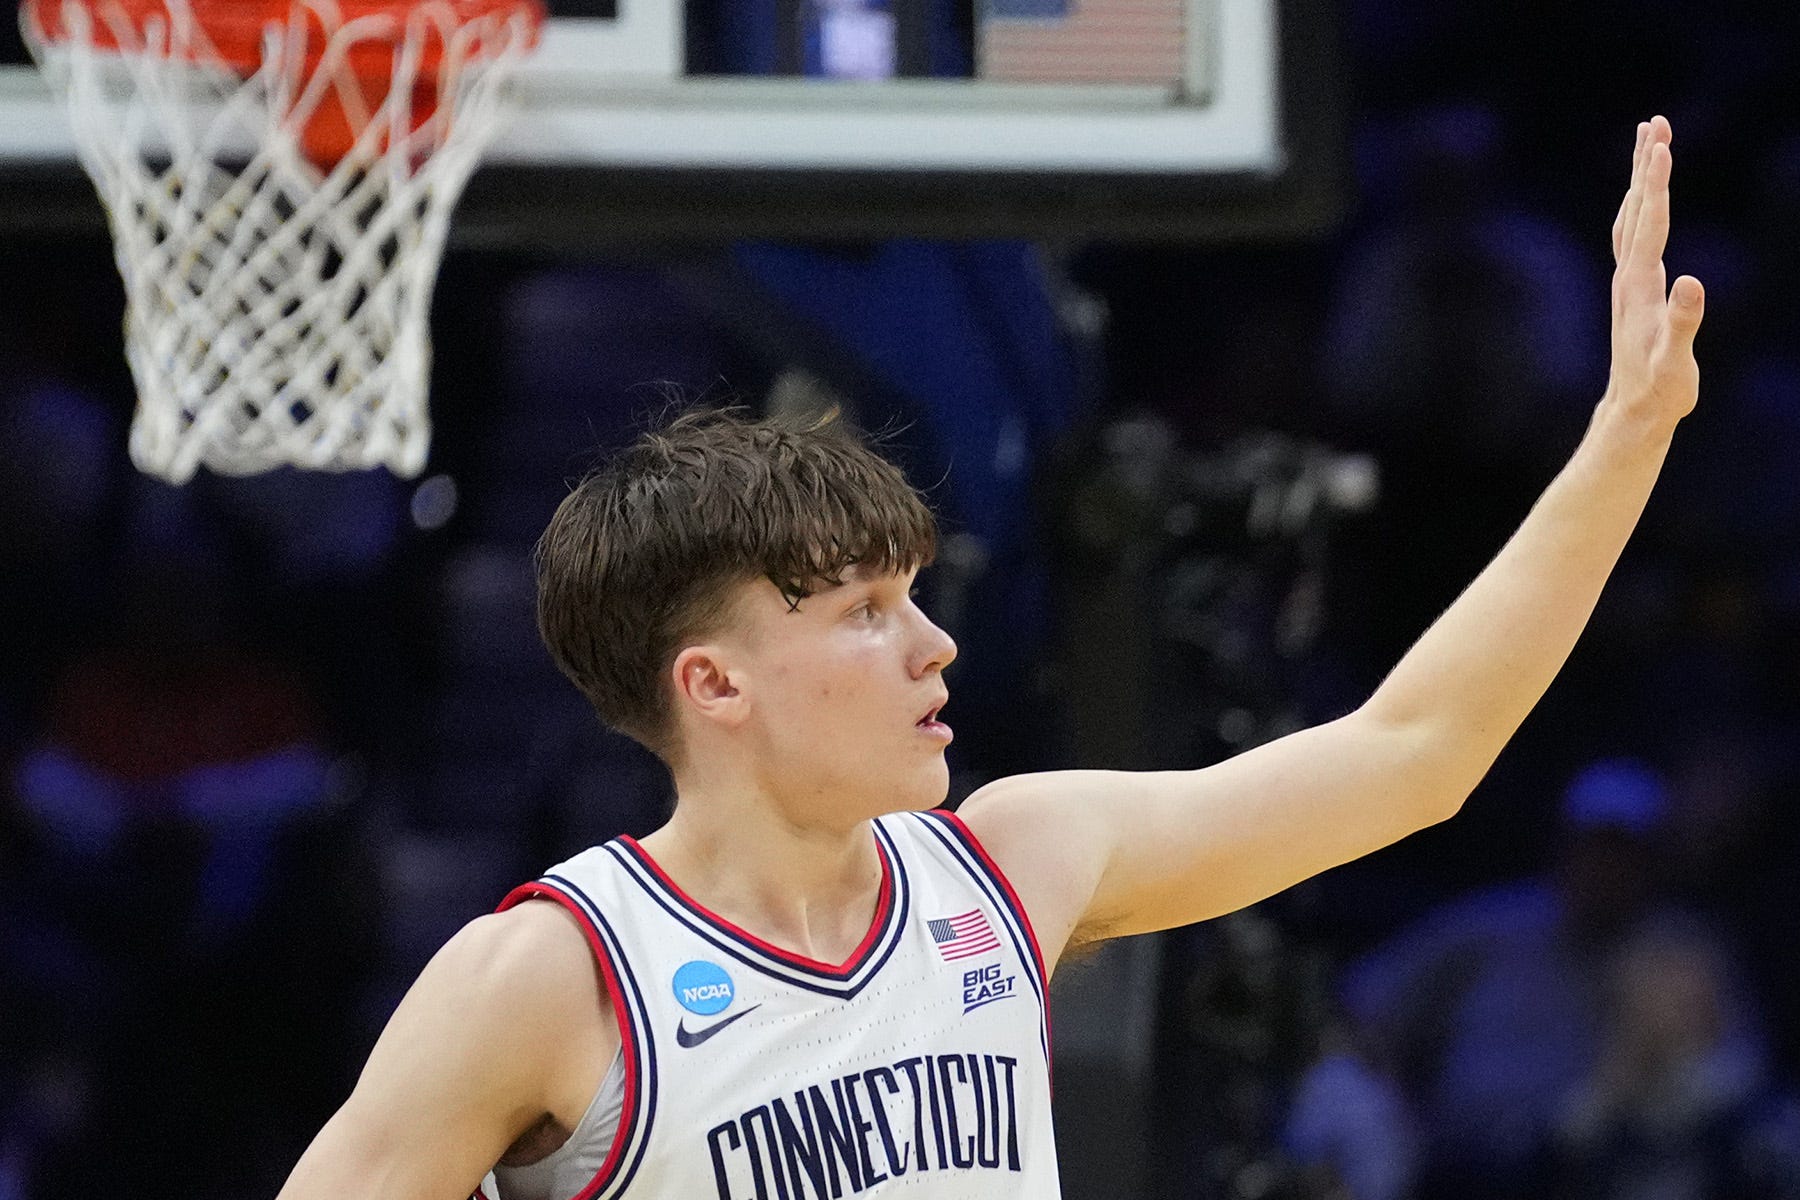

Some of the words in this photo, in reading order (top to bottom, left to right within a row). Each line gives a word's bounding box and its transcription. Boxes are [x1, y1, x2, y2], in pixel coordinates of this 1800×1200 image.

[963, 963, 1001, 988] BIG
[683, 983, 731, 1003] NCAA
[963, 976, 1016, 1004] EAST
